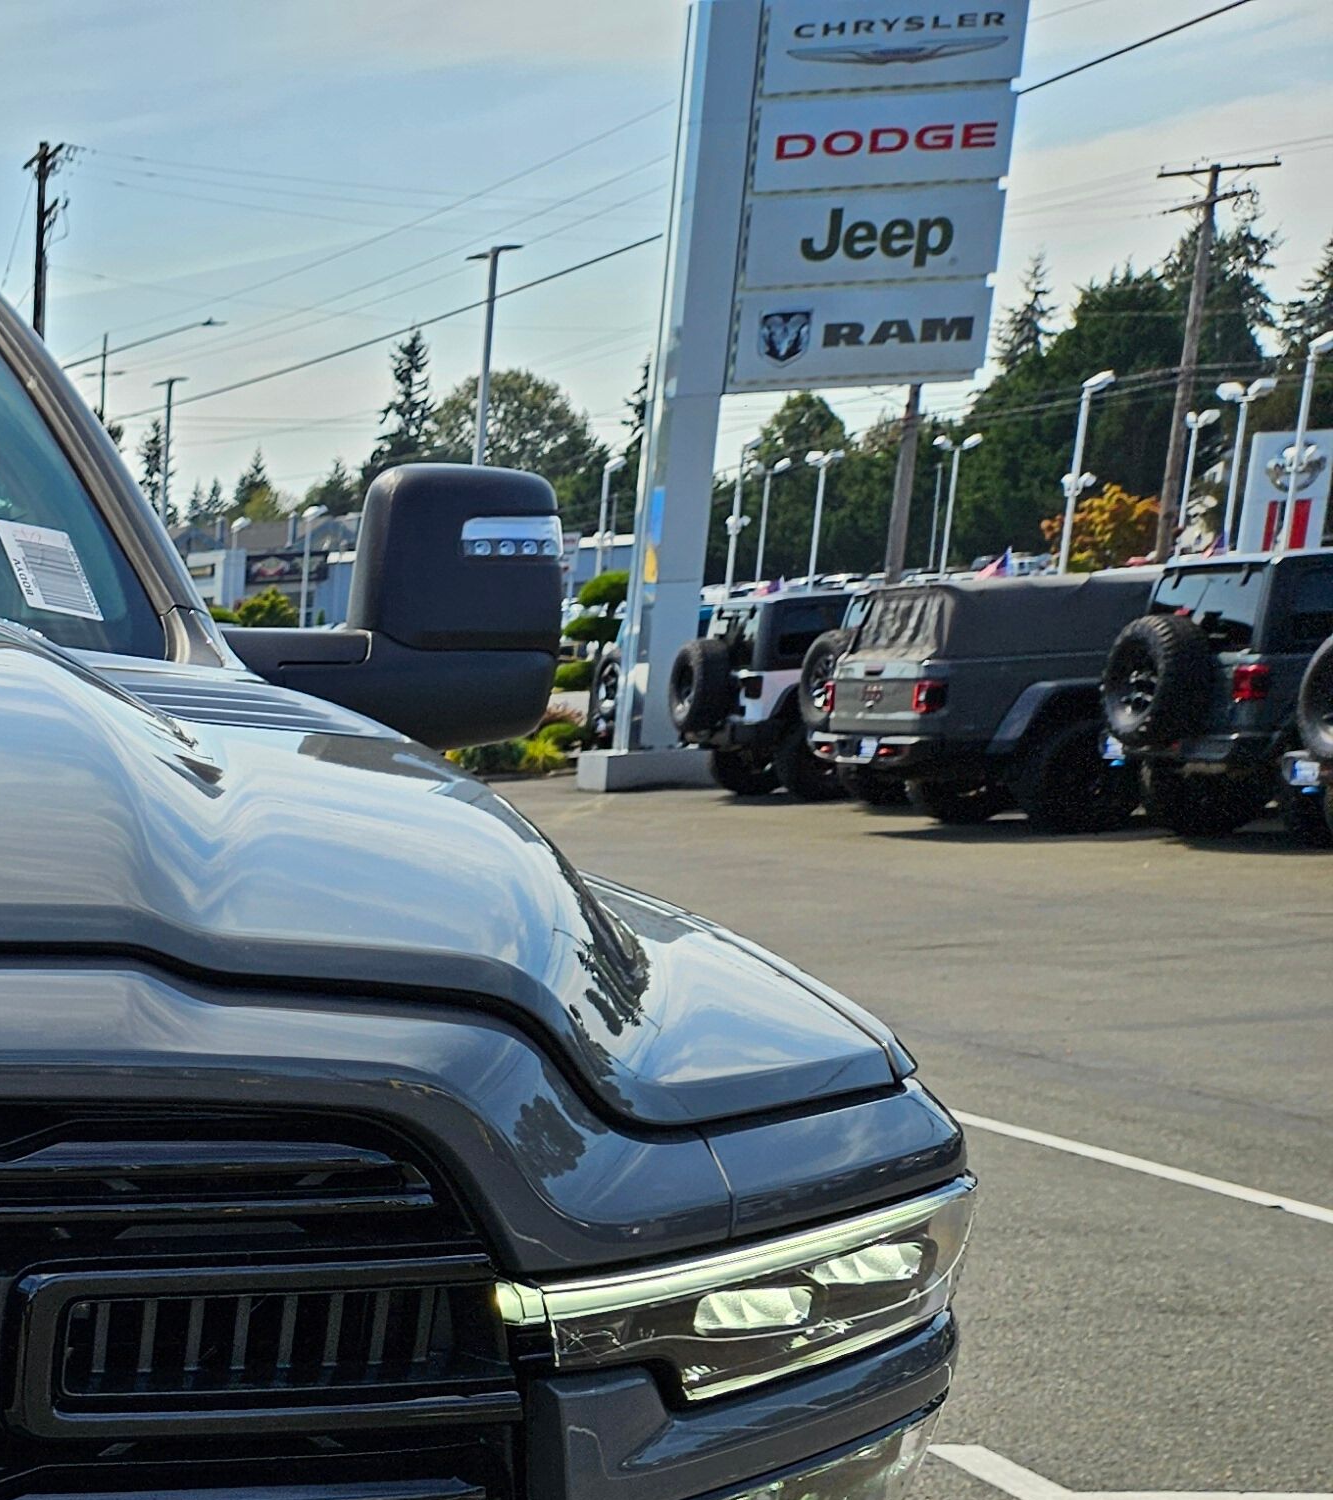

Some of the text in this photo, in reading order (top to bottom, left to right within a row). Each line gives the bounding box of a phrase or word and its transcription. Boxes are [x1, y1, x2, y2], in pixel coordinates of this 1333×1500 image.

[793, 11, 1007, 39] CHRYSLER
[774, 121, 999, 160] DODGE
[800, 207, 955, 268] Jeep
[822, 316, 975, 349] RAM
